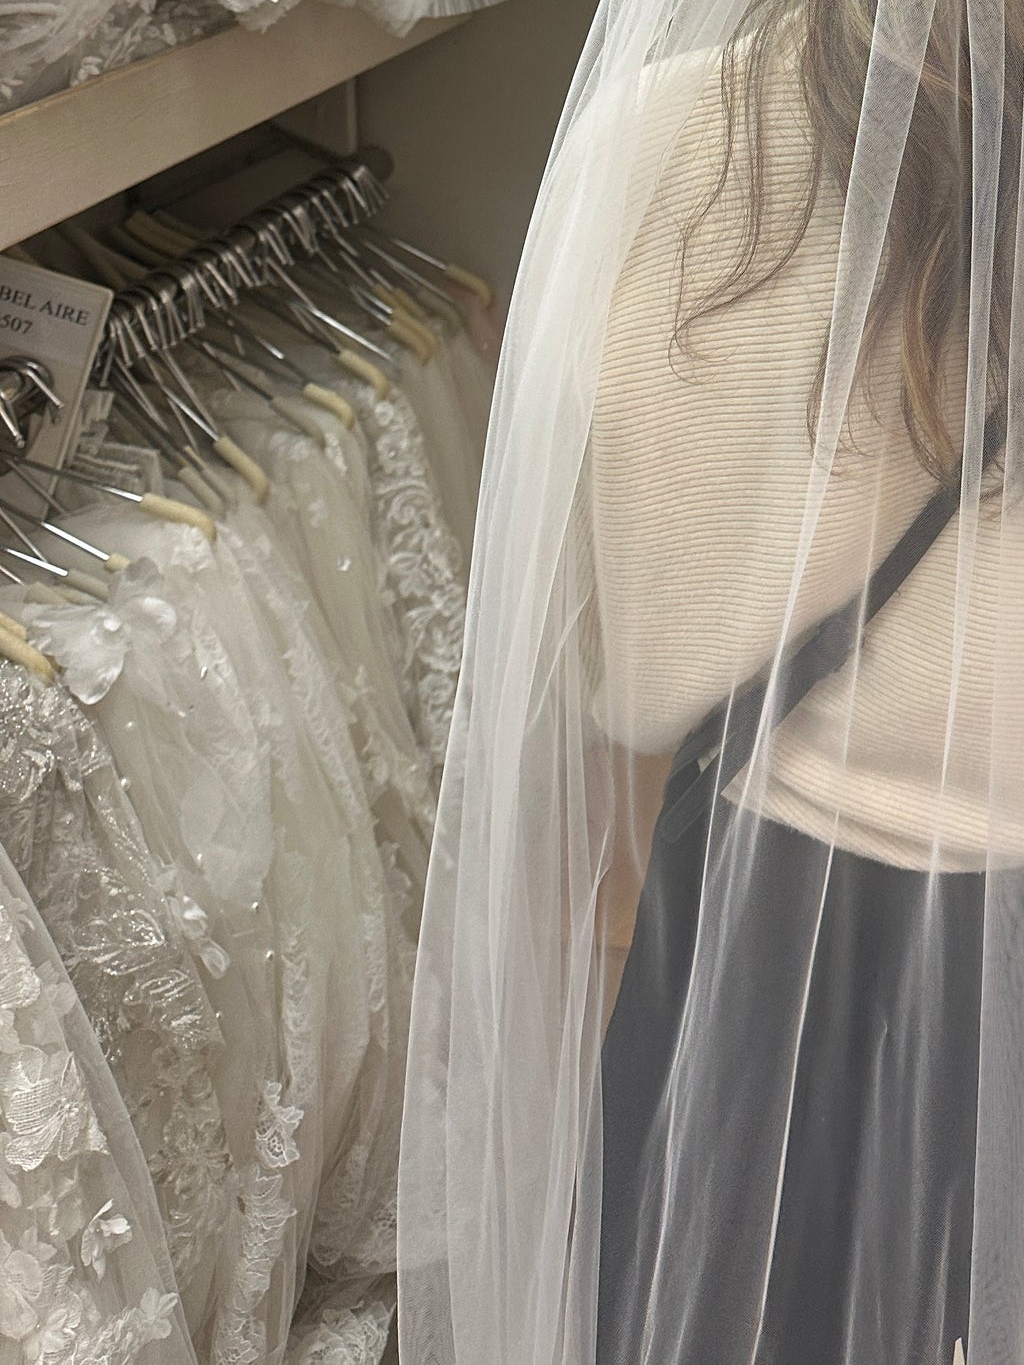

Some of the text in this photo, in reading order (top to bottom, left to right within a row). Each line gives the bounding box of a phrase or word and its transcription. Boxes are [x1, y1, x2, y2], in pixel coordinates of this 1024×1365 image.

[0, 285, 89, 326] BEL AIRE
[0, 314, 33, 335] 507
